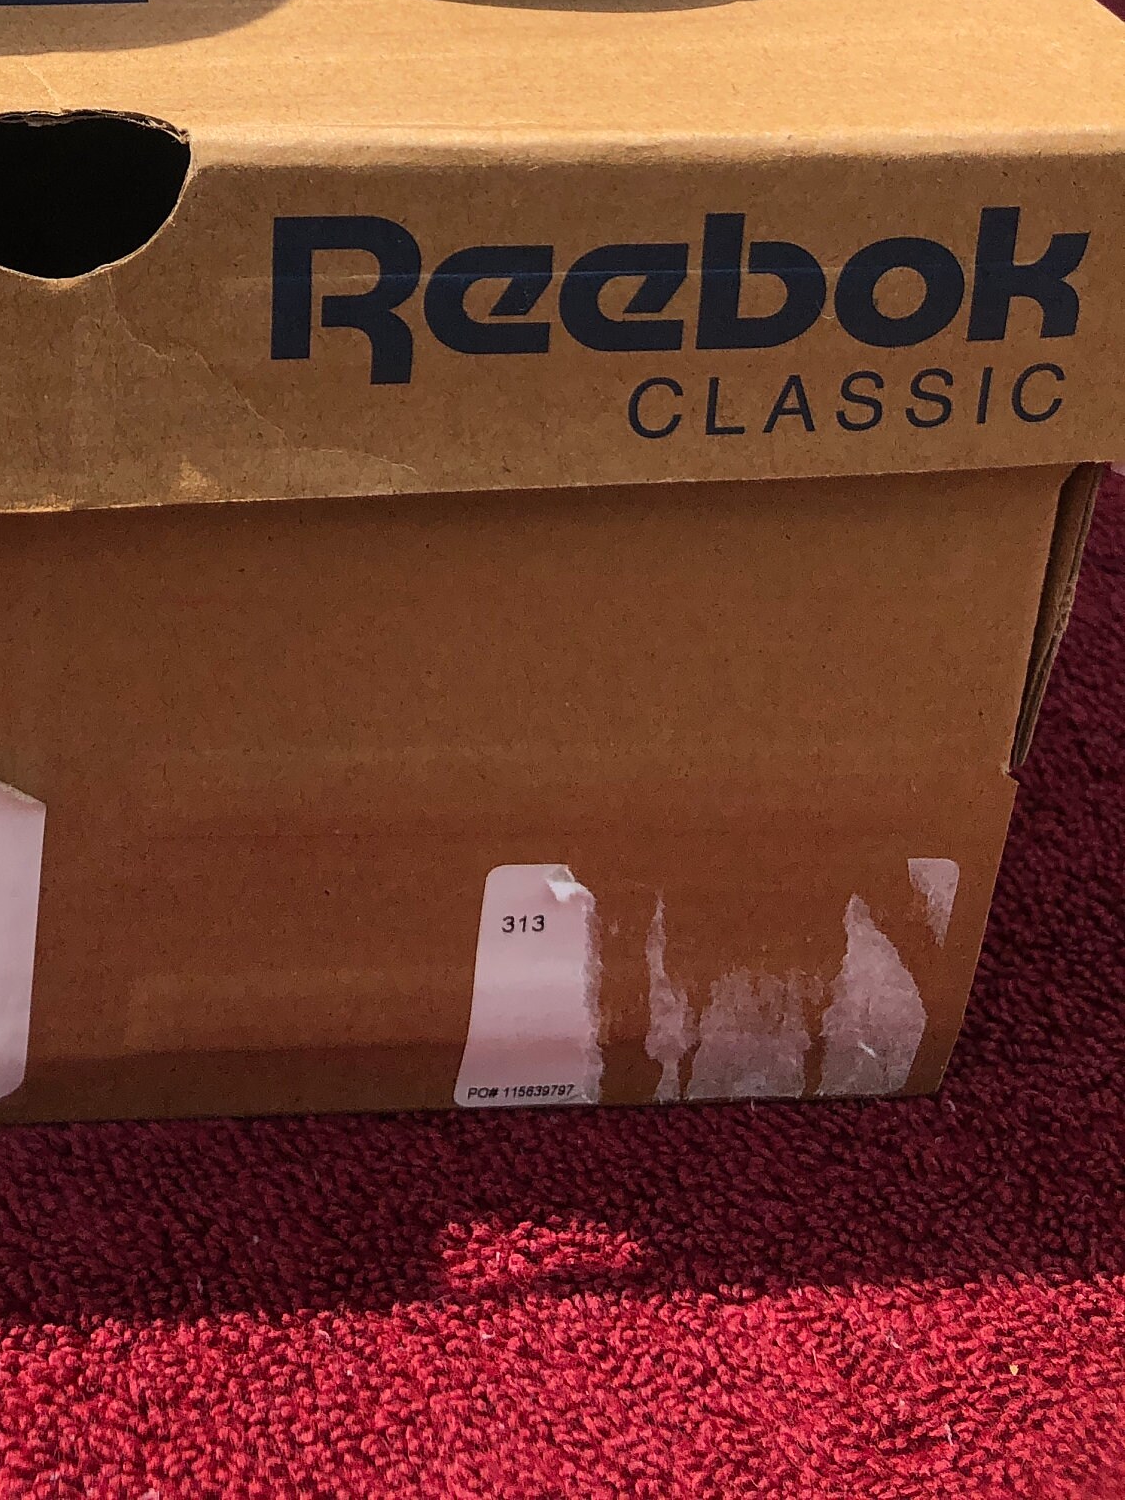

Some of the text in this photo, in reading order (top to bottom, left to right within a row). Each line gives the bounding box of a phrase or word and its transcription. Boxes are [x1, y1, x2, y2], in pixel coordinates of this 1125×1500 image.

[270, 206, 1090, 385] Reebok
[627, 361, 1066, 440] CLASSIC
[501, 915, 546, 934] 313
[468, 1084, 575, 1099] PO# 115639797
